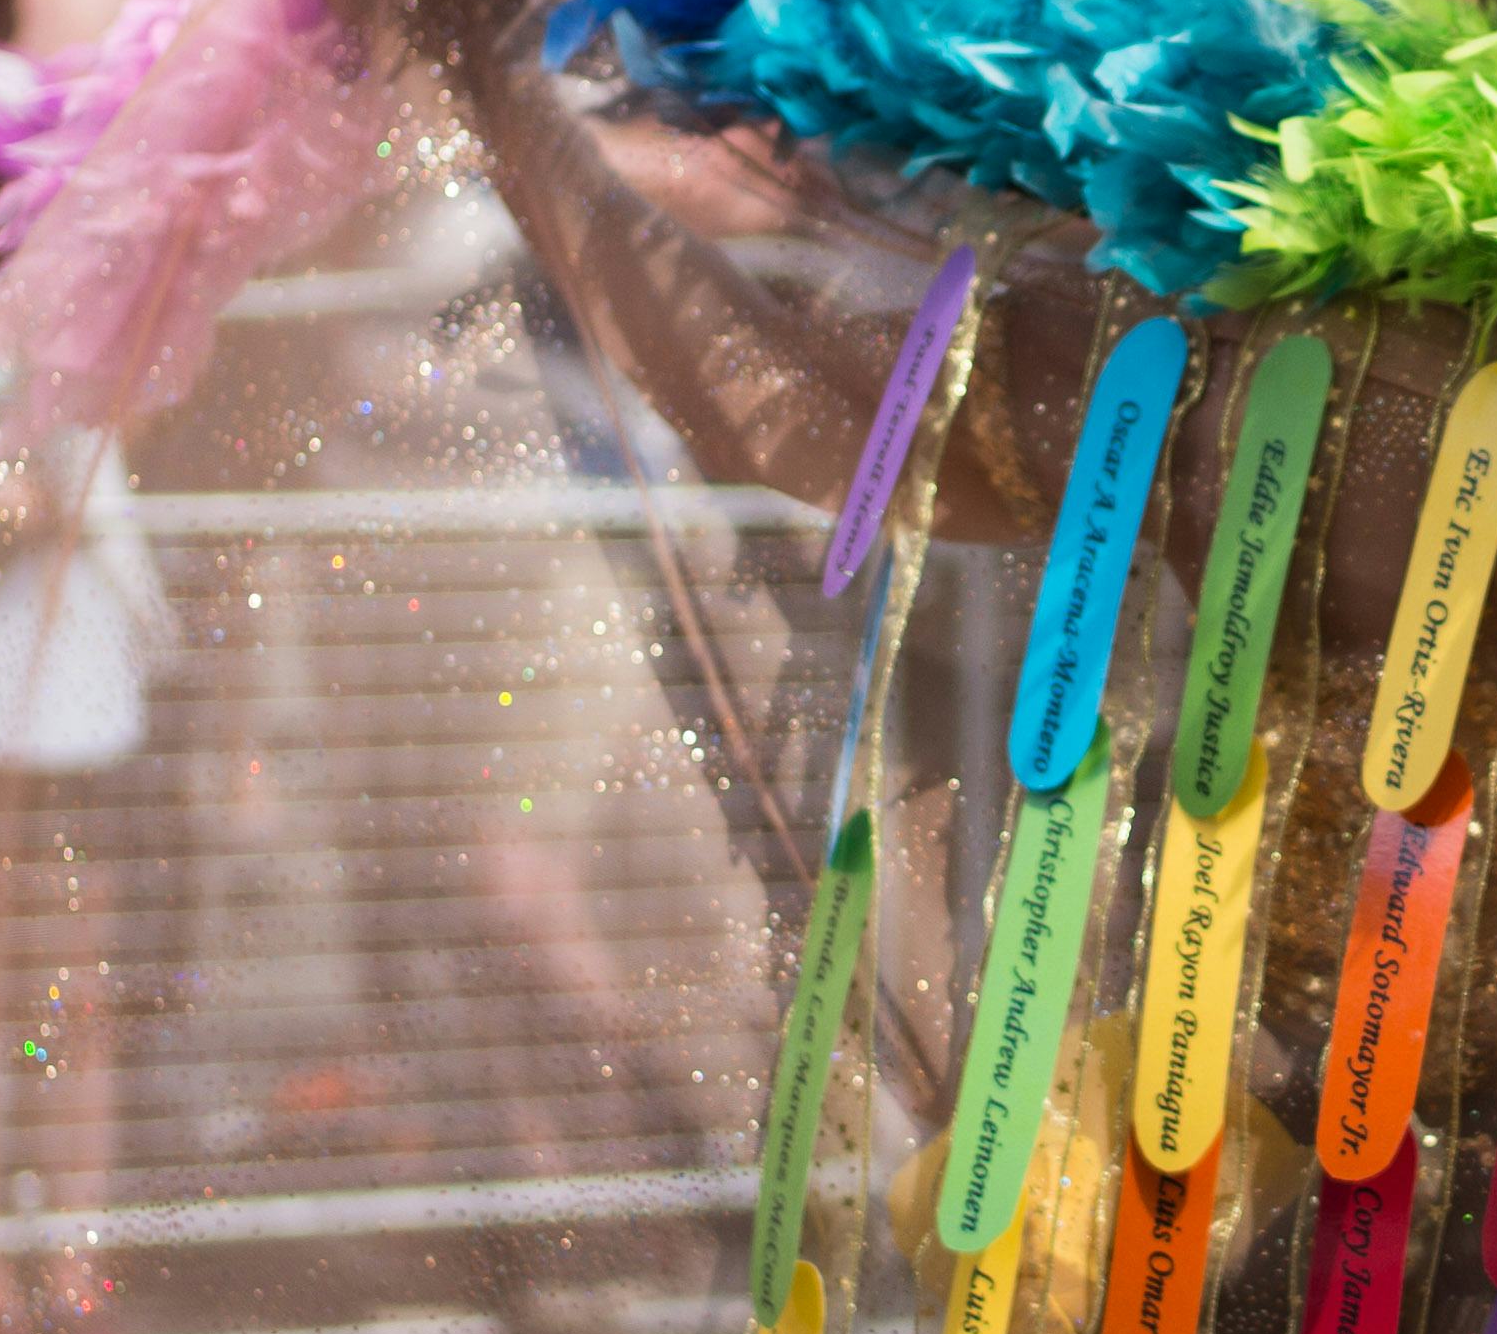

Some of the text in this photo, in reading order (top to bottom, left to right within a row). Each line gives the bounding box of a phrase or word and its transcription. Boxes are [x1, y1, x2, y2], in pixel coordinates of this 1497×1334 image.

[1033, 400, 1141, 773] Oscar A Aracena-Montero
[1195, 439, 1284, 796] Eddie Jamoldroy Justice
[1386, 448, 1489, 788] Eric Ivan Ortiz-Rivera
[960, 798, 1075, 1231] Christopher Andrew Leinonen
[1156, 833, 1222, 1151] Joel Rayon Paniagua
[1339, 821, 1425, 1155] Edward Sotomayor Jr.
[963, 1266, 994, 1334] Luis
[1153, 1172, 1186, 1242] Luis
[1340, 1186, 1383, 1257] Cory
